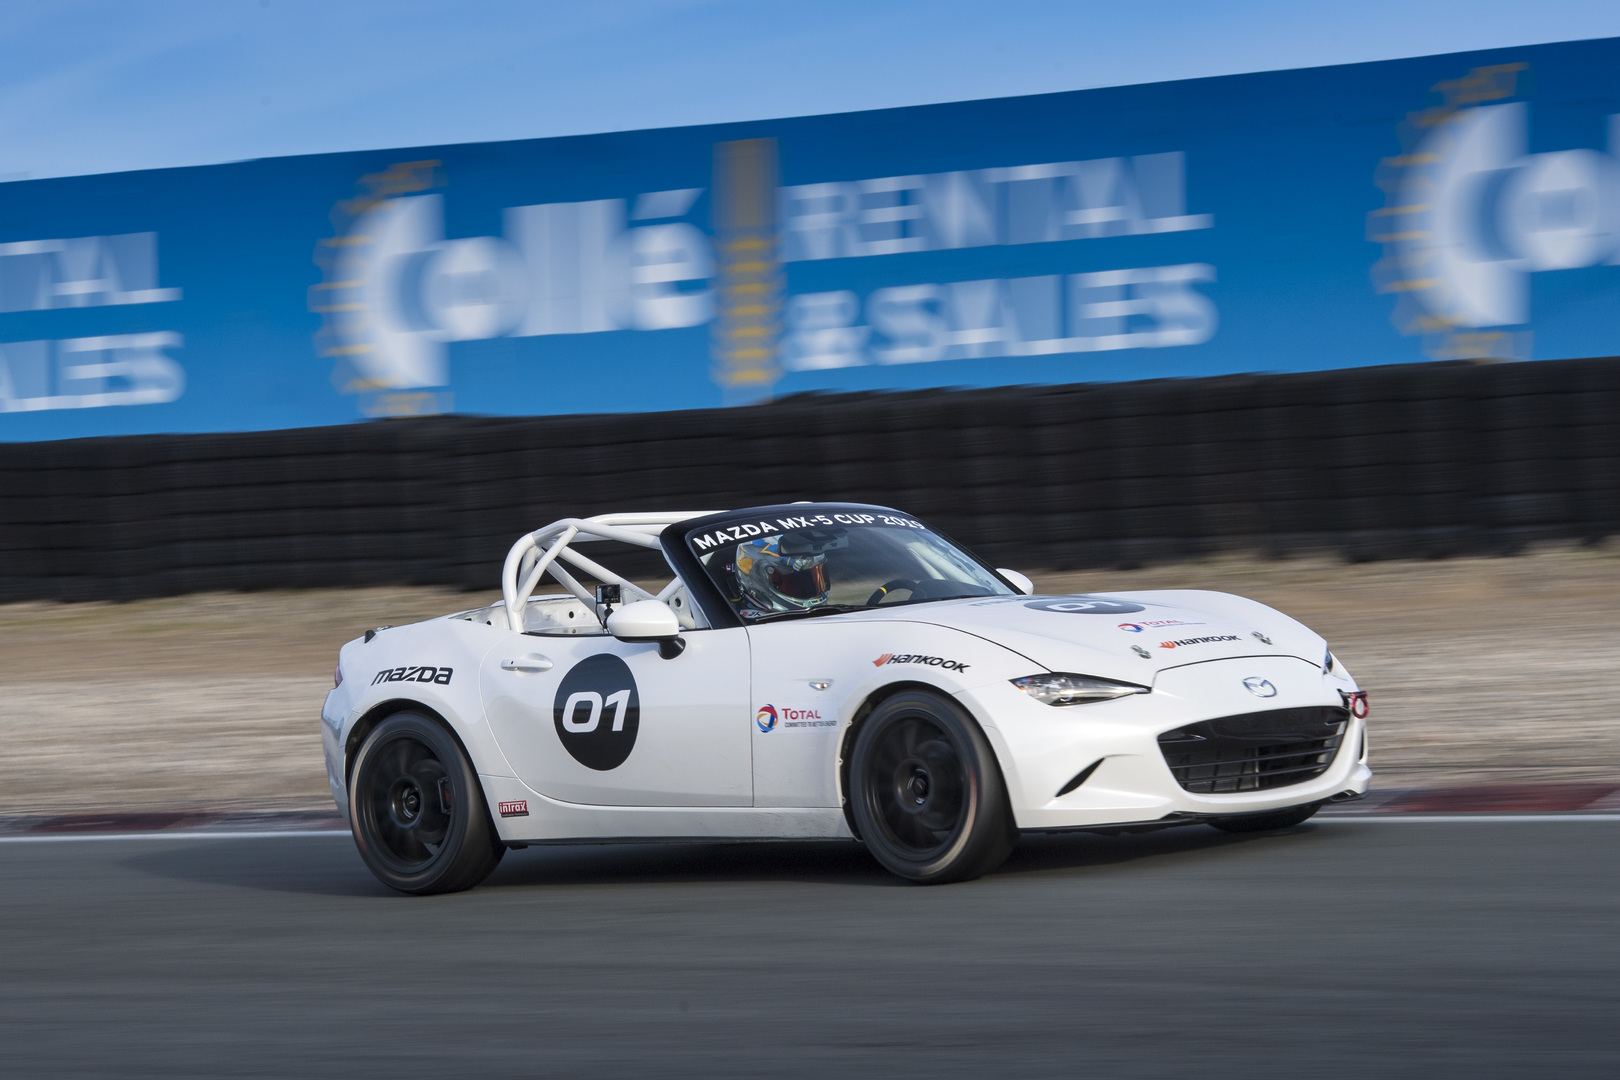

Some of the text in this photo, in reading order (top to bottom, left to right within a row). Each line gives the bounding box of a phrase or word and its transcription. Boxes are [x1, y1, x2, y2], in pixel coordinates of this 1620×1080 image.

[778, 150, 1214, 262] RENTAL
[866, 262, 1219, 364] SALES
[693, 513, 926, 550] MAZDA MX-5 CUP 2019
[562, 689, 631, 733] 01
[781, 708, 822, 720] TOTAL
